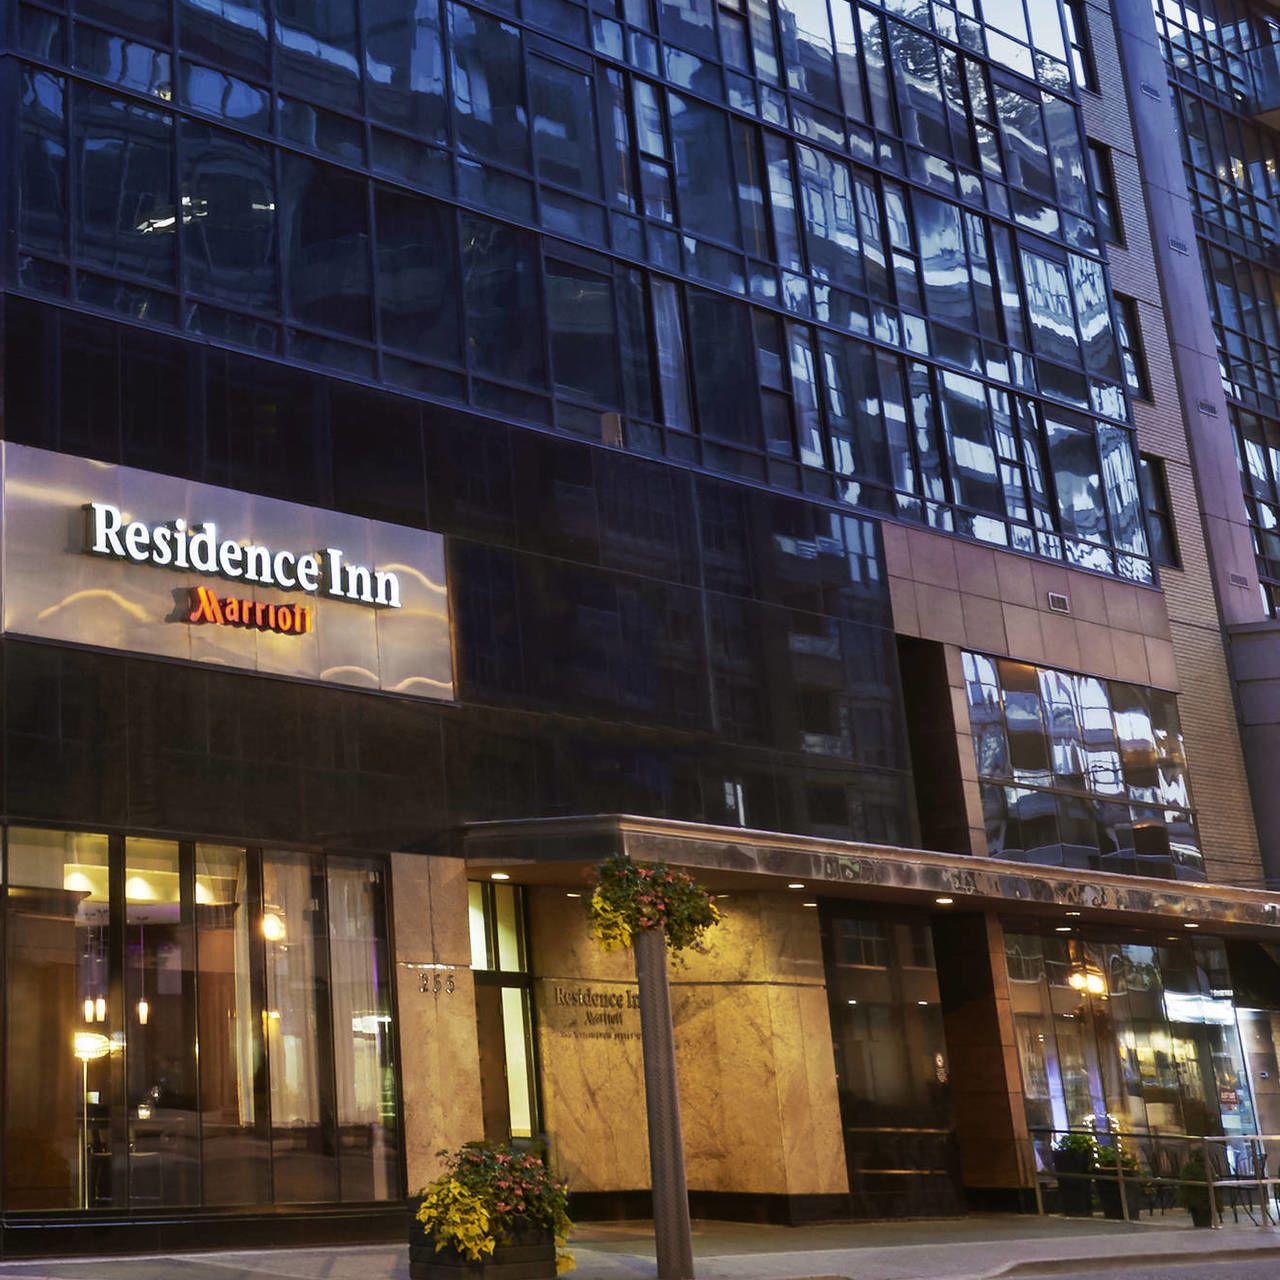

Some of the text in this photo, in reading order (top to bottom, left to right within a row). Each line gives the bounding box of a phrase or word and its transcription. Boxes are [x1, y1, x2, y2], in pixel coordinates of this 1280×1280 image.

[90, 501, 403, 609] Residence Inn
[190, 585, 313, 634] Marriott
[554, 986, 624, 1009] Residence
